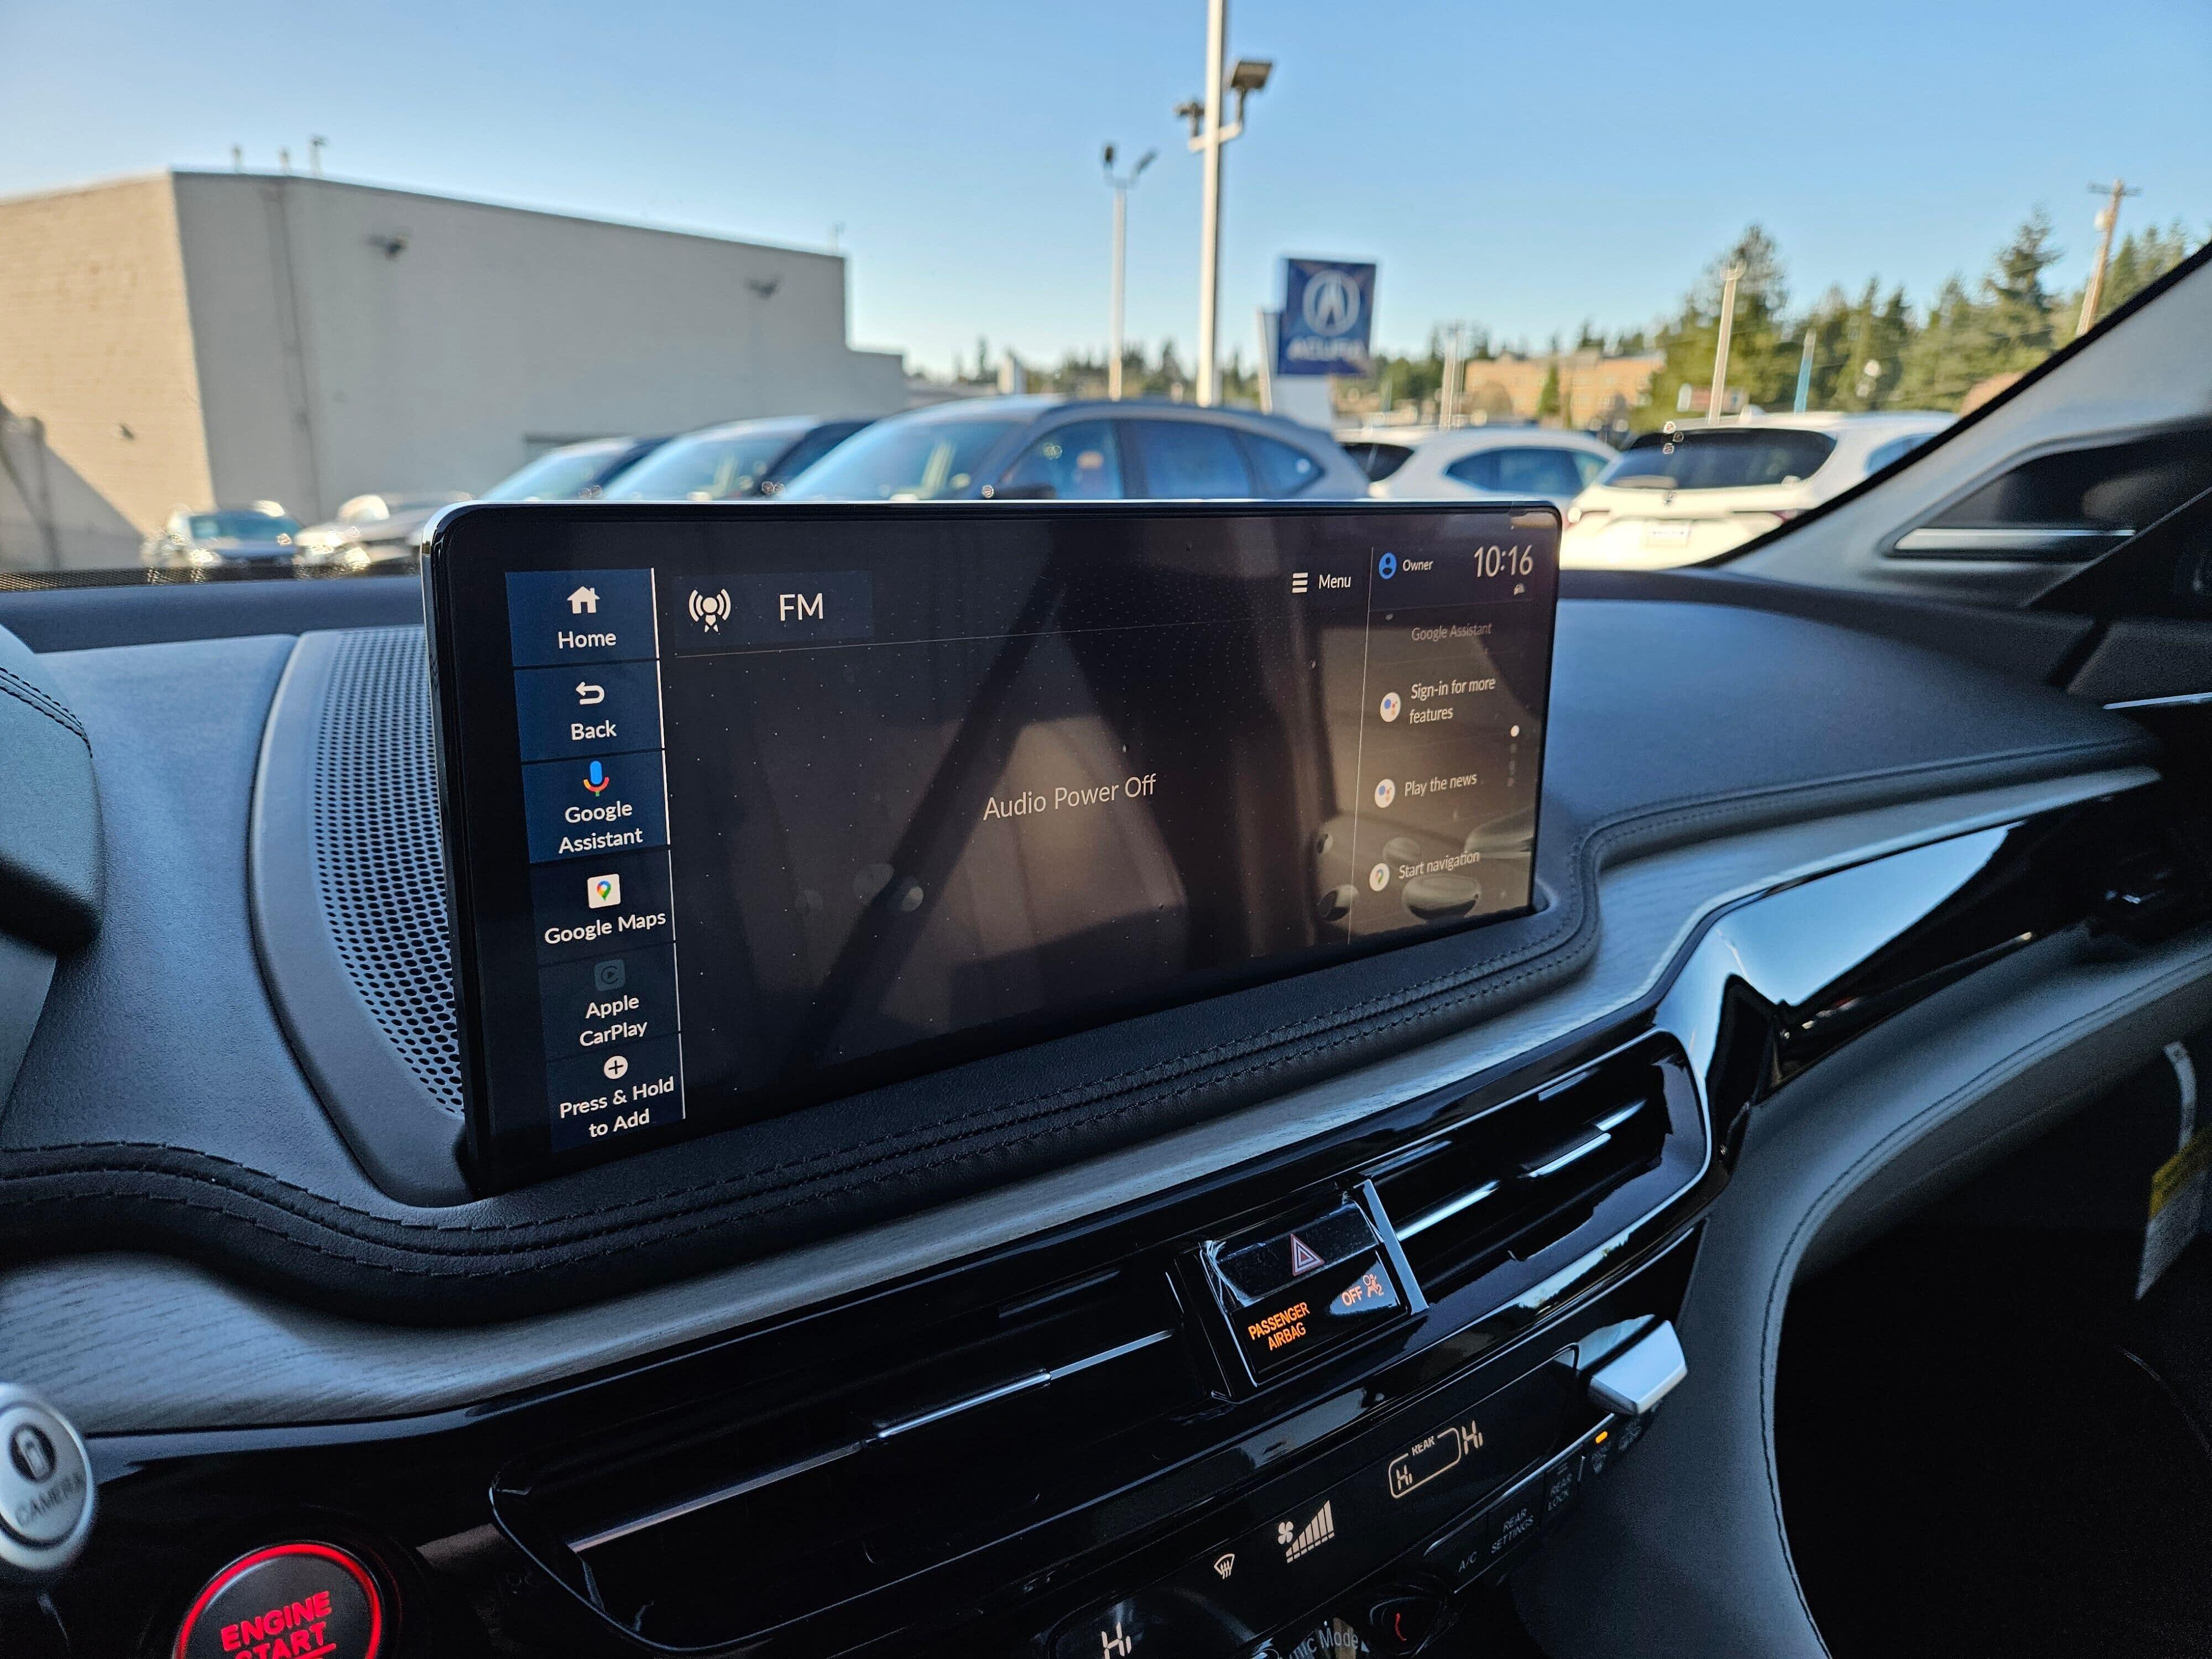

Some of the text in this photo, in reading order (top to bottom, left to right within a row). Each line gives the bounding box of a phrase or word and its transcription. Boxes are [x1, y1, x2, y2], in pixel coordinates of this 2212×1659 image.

[1402, 559, 1434, 571] Owner
[1474, 544, 1533, 577] 10:16
[1318, 574, 1352, 589] Menu
[780, 593, 823, 622] FM
[558, 630, 617, 649] Home
[1411, 623, 1493, 641] Google Assistant
[1410, 676, 1496, 700] Sign-in for more
[1408, 707, 1454, 724] features
[571, 719, 617, 740] Back
[983, 773, 1156, 821] Audio Power Off
[1404, 773, 1478, 797] Play the news
[565, 800, 633, 823] Google
[559, 828, 644, 854] Assistant
[1399, 849, 1480, 879] Start navigation
[544, 913, 666, 944] Google Maps
[585, 995, 639, 1019] Apple
[580, 1021, 648, 1046] CarPlay
[560, 1076, 674, 1119] Press & Hold
[588, 1108, 650, 1138] to Add
[1342, 1286, 1363, 1306] OFF
[1248, 1302, 1310, 1340] PASSENGER
[1268, 1322, 1306, 1351] AIRBAG
[1411, 1436, 1436, 1455] REAR
[1503, 1508, 1527, 1532] REAR
[1491, 1515, 1534, 1553] SETTINGS
[1458, 1551, 1478, 1572] A/C
[221, 1590, 332, 1652] ENGINE
[1318, 1627, 1358, 1649] Mode
